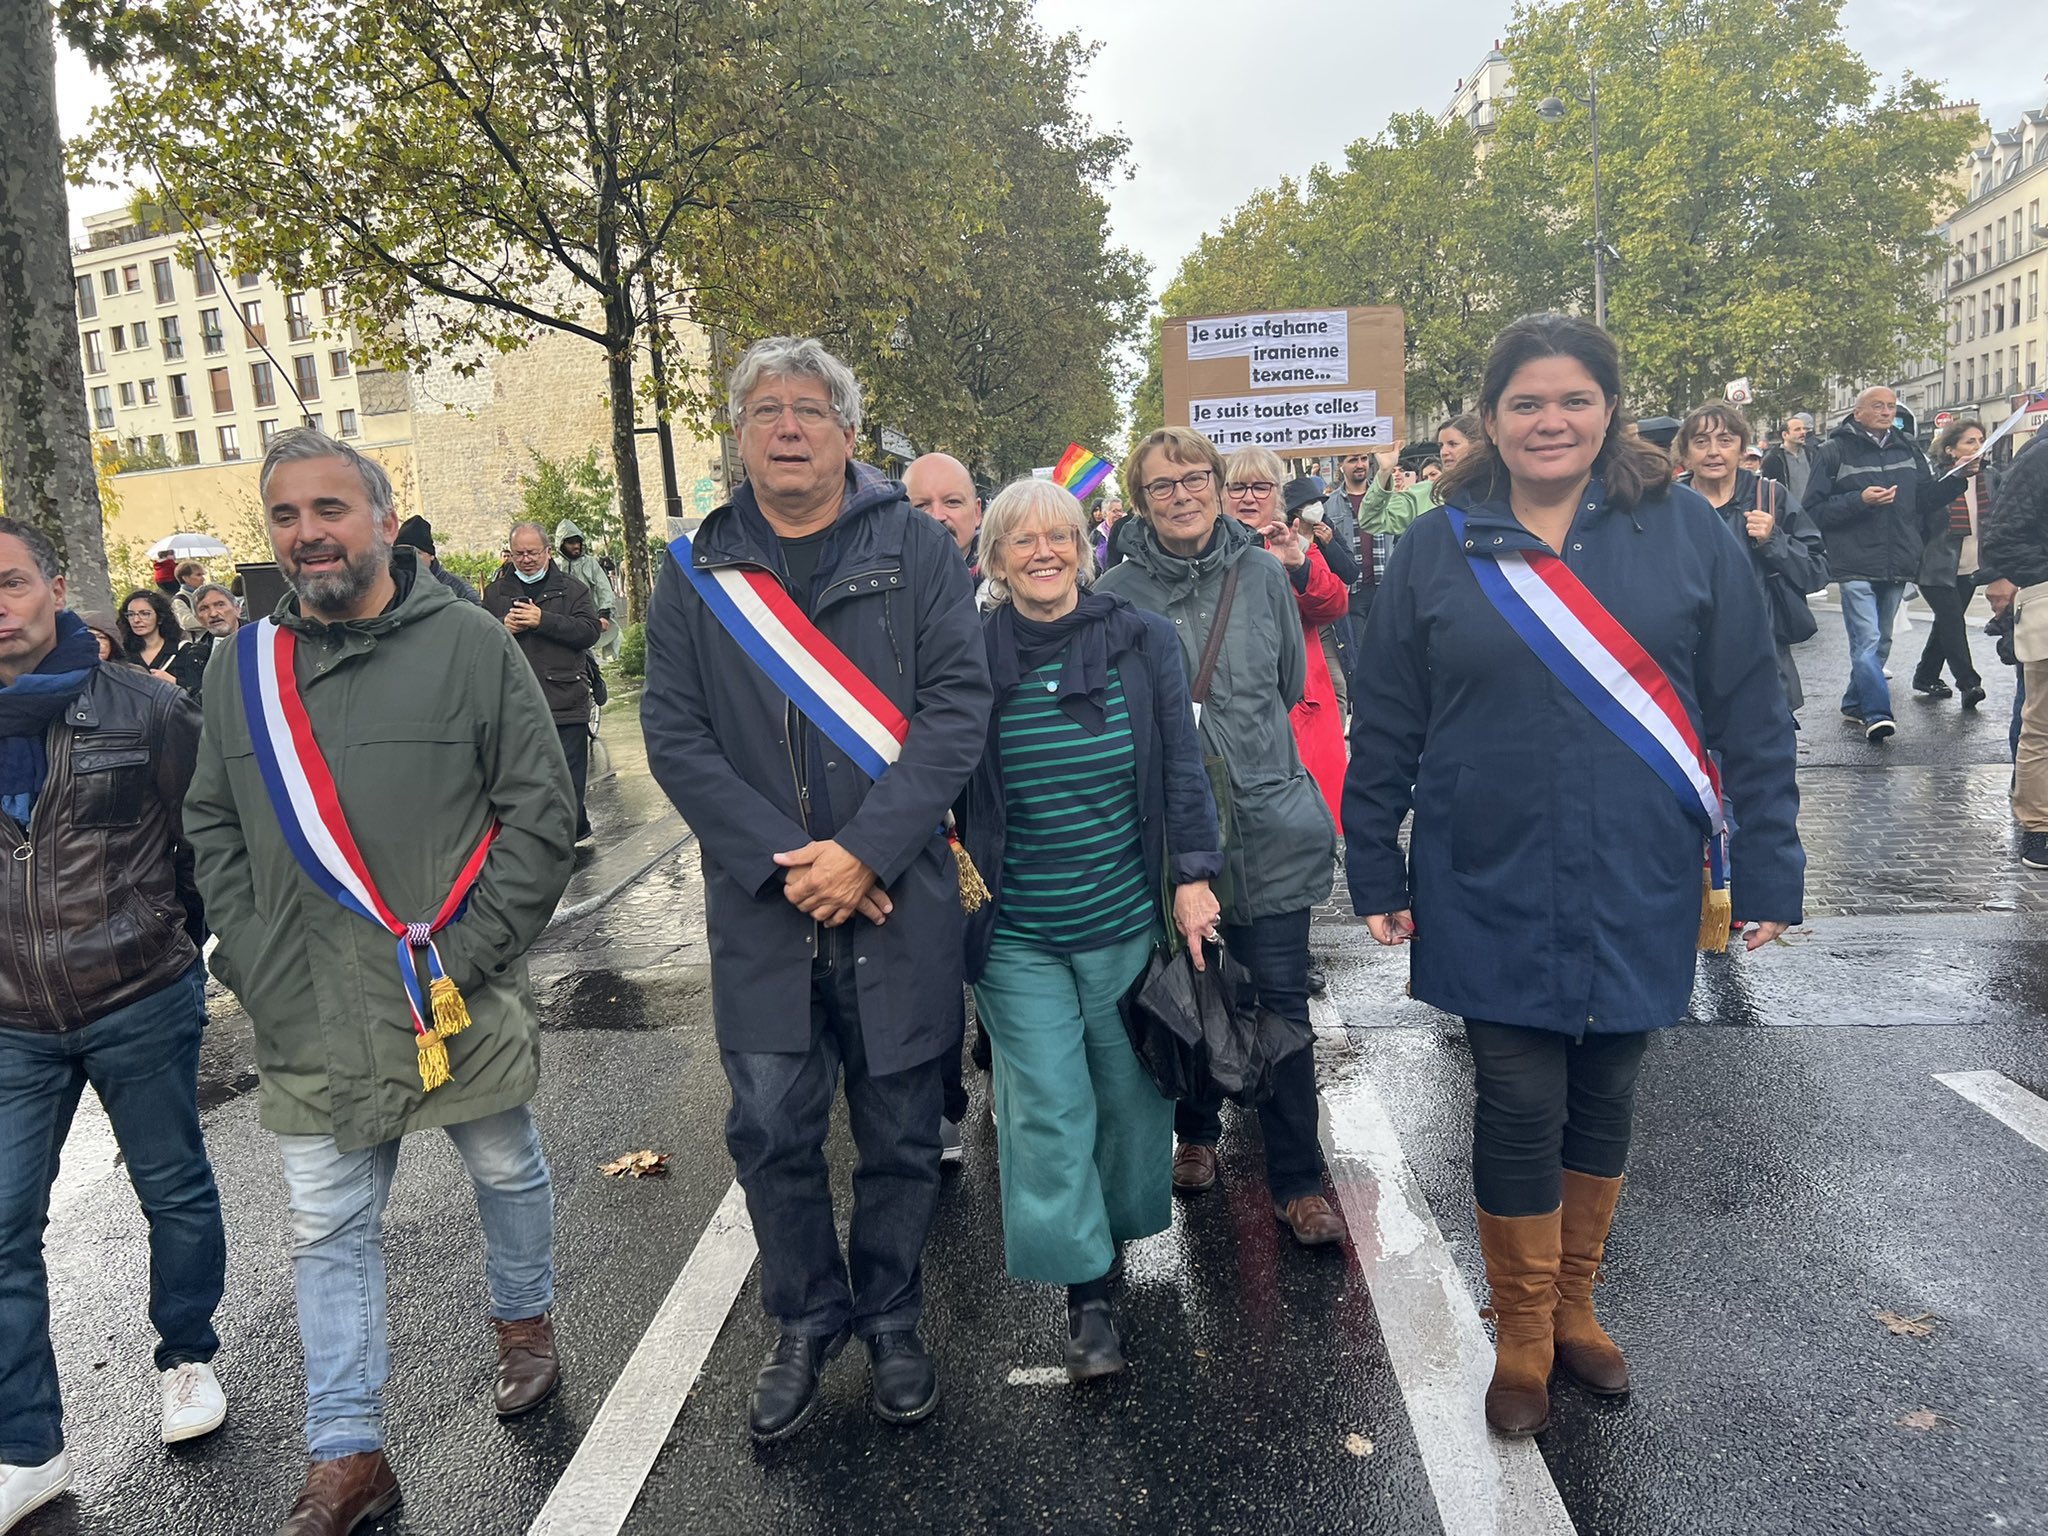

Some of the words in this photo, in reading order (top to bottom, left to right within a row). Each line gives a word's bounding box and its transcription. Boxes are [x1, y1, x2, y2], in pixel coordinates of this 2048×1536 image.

[1191, 326, 1209, 343] Je
[1215, 323, 1247, 340] suis
[1252, 320, 1328, 338] afghane
[1254, 344, 1339, 361] iranienne
[1253, 367, 1331, 382] texane...
[1194, 405, 1211, 422] Je
[1217, 403, 1248, 418] suis
[1254, 402, 1309, 418] toutes
[1315, 398, 1359, 414] celles
[1205, 429, 1224, 443] ui
[1231, 430, 1252, 443] ne
[1255, 428, 1292, 443] sont
[1298, 427, 1327, 443] pas
[1333, 423, 1376, 439] libres
